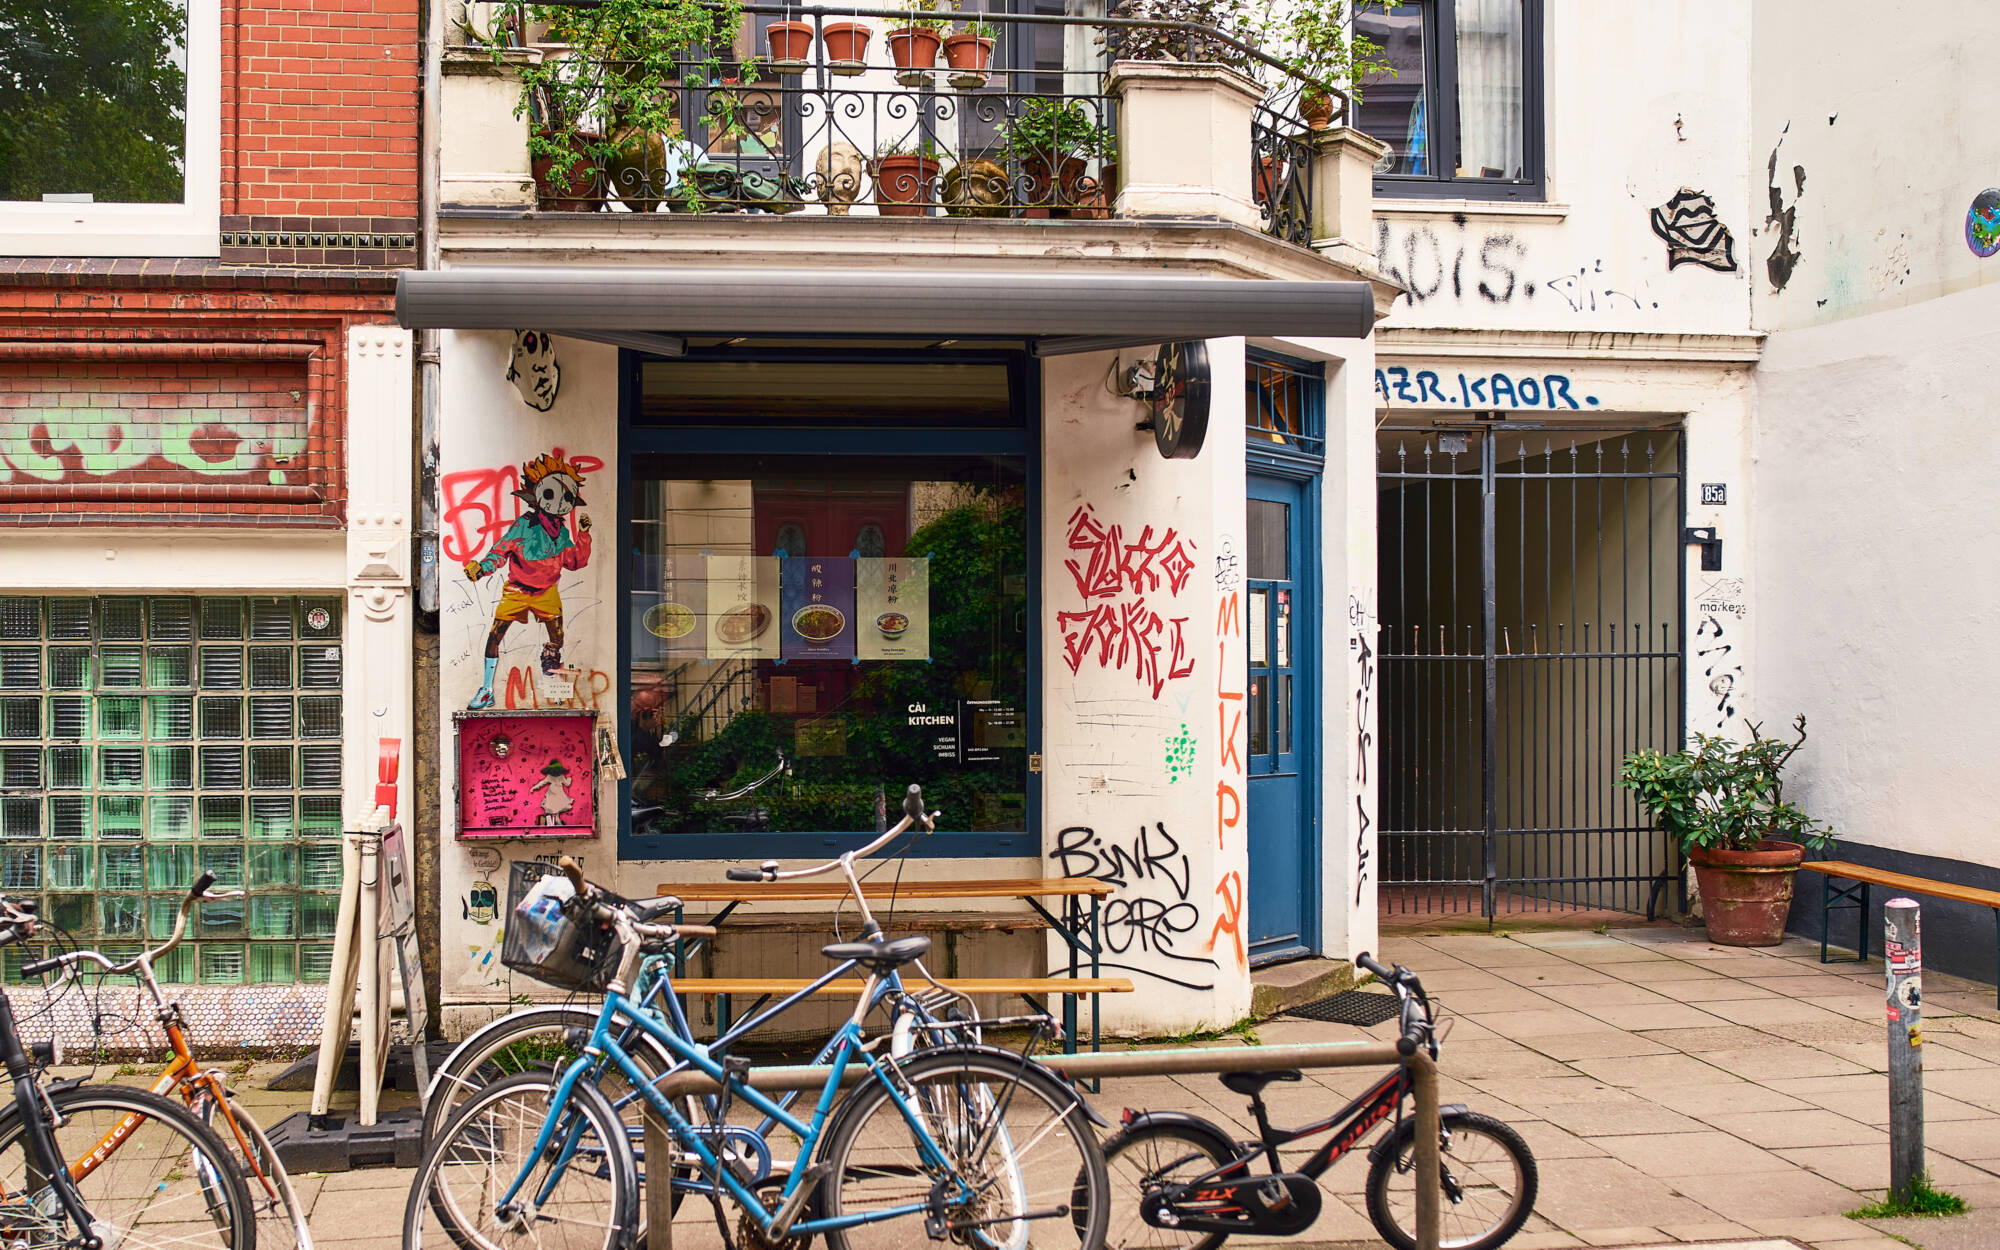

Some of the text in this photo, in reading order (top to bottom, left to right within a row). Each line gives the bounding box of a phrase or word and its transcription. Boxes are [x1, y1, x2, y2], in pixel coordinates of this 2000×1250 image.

[1704, 486, 1724, 502] 85a
[908, 702, 926, 713] CÀI
[908, 716, 954, 726] KITCHEN
[82, 1112, 141, 1168] PEUGE
